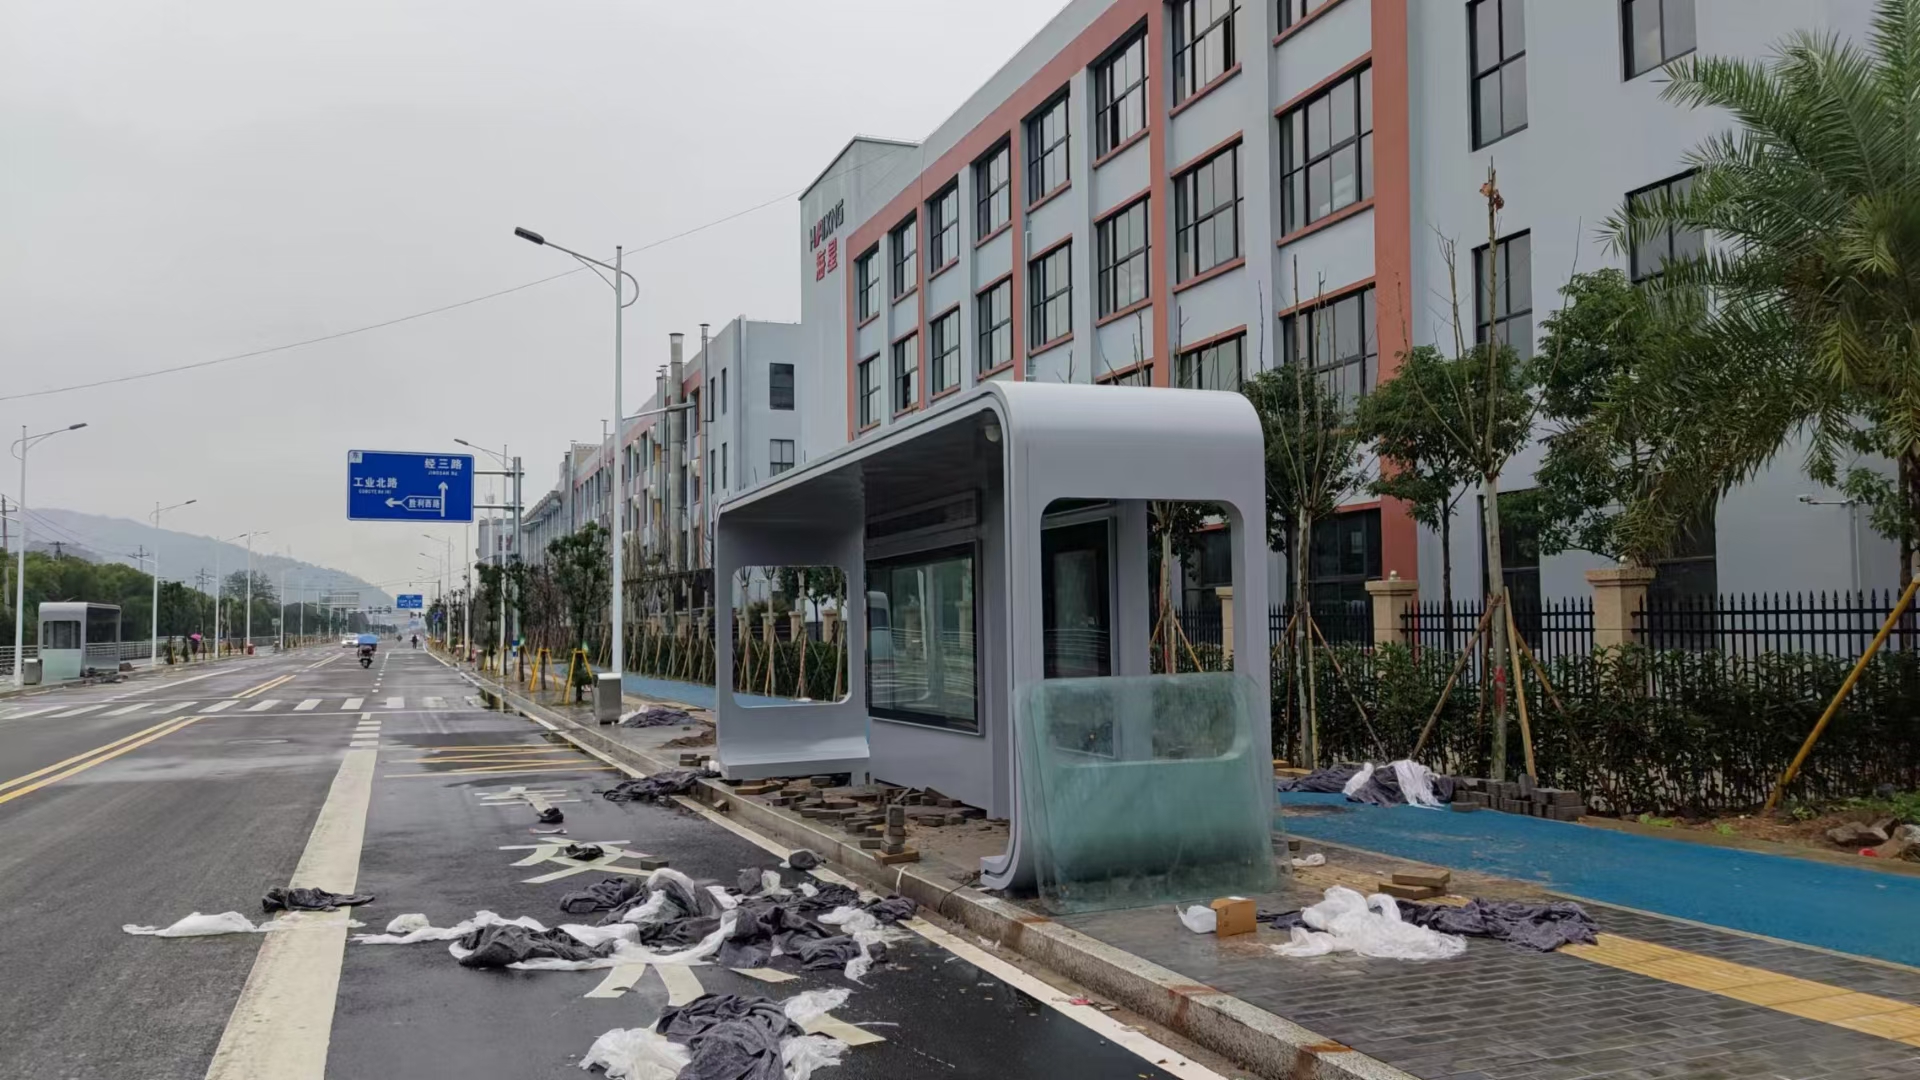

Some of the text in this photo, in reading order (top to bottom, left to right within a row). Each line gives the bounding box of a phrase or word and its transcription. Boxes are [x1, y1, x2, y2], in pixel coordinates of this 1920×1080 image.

[424, 458, 463, 470] 经三路
[353, 477, 398, 489] 工业北路
[408, 498, 440, 509] 胜利西路
